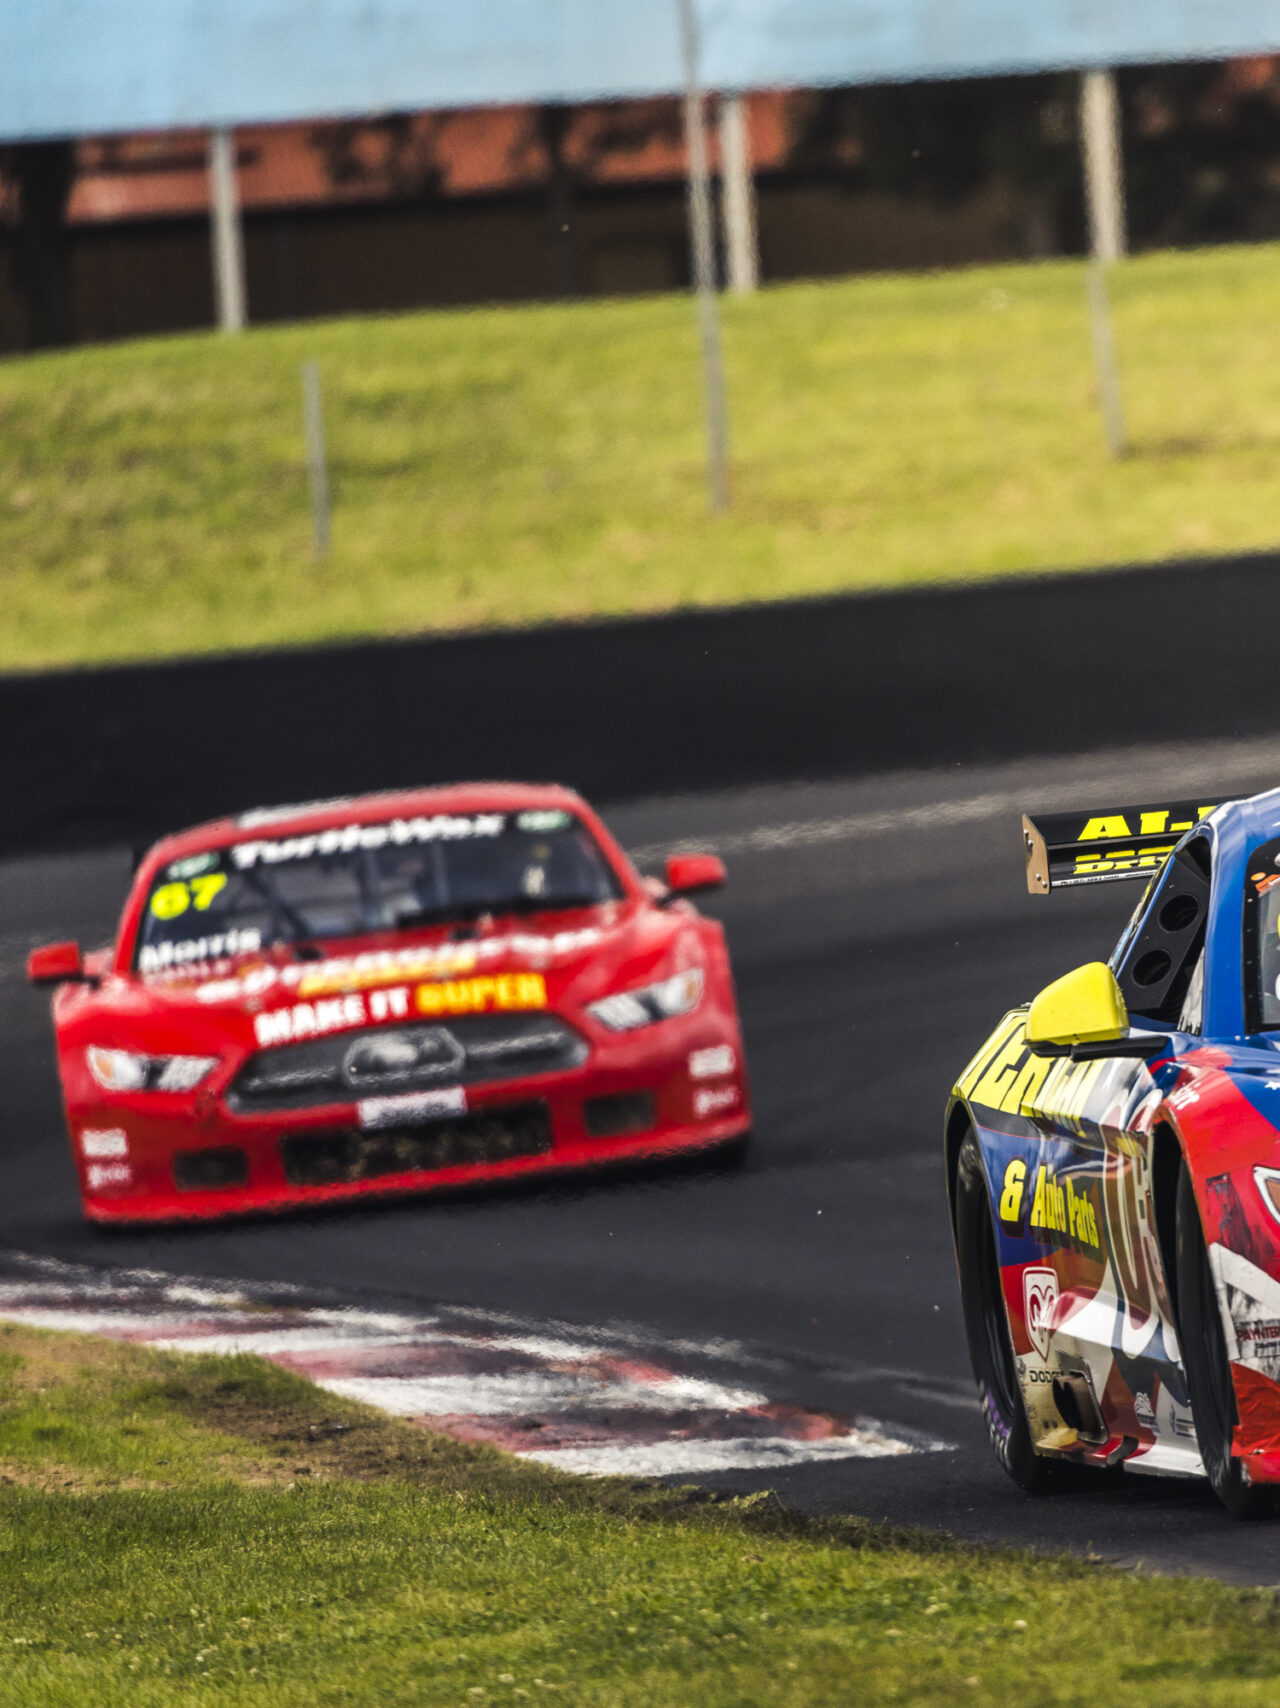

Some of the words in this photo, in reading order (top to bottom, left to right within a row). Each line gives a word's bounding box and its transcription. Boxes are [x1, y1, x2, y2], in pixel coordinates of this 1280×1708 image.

[1076, 805, 1216, 862] AL
[254, 993, 367, 1048] MAKE
[368, 985, 410, 1021] IT
[415, 972, 548, 1014] SUPER
[1000, 1159, 1027, 1223] &
[1029, 1164, 1067, 1234] Auto
[1065, 1174, 1100, 1250] Parts
